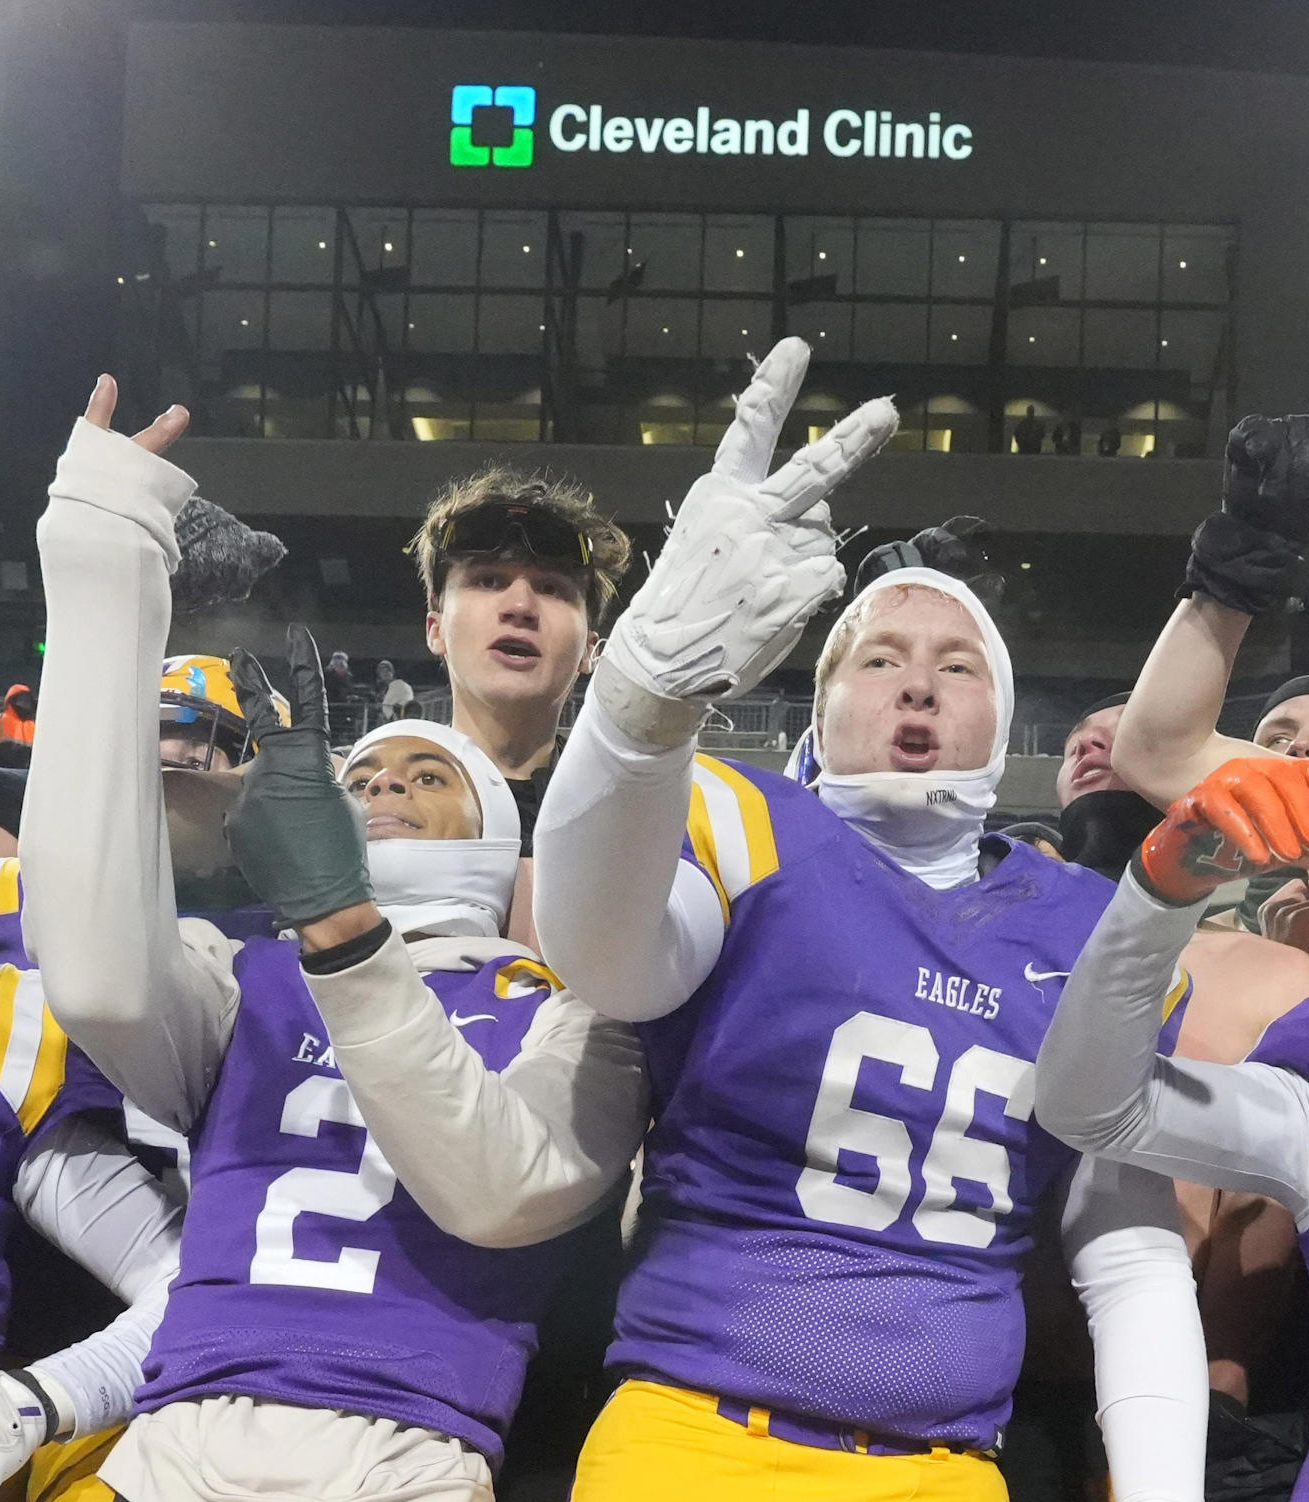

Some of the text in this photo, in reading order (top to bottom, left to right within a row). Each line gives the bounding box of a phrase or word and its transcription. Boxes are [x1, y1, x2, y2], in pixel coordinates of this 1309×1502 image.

[549, 104, 973, 160] Cleveland Clinic
[915, 966, 1003, 1020] EAGLES
[250, 1074, 397, 1295] 2
[795, 1011, 1036, 1249] 66
